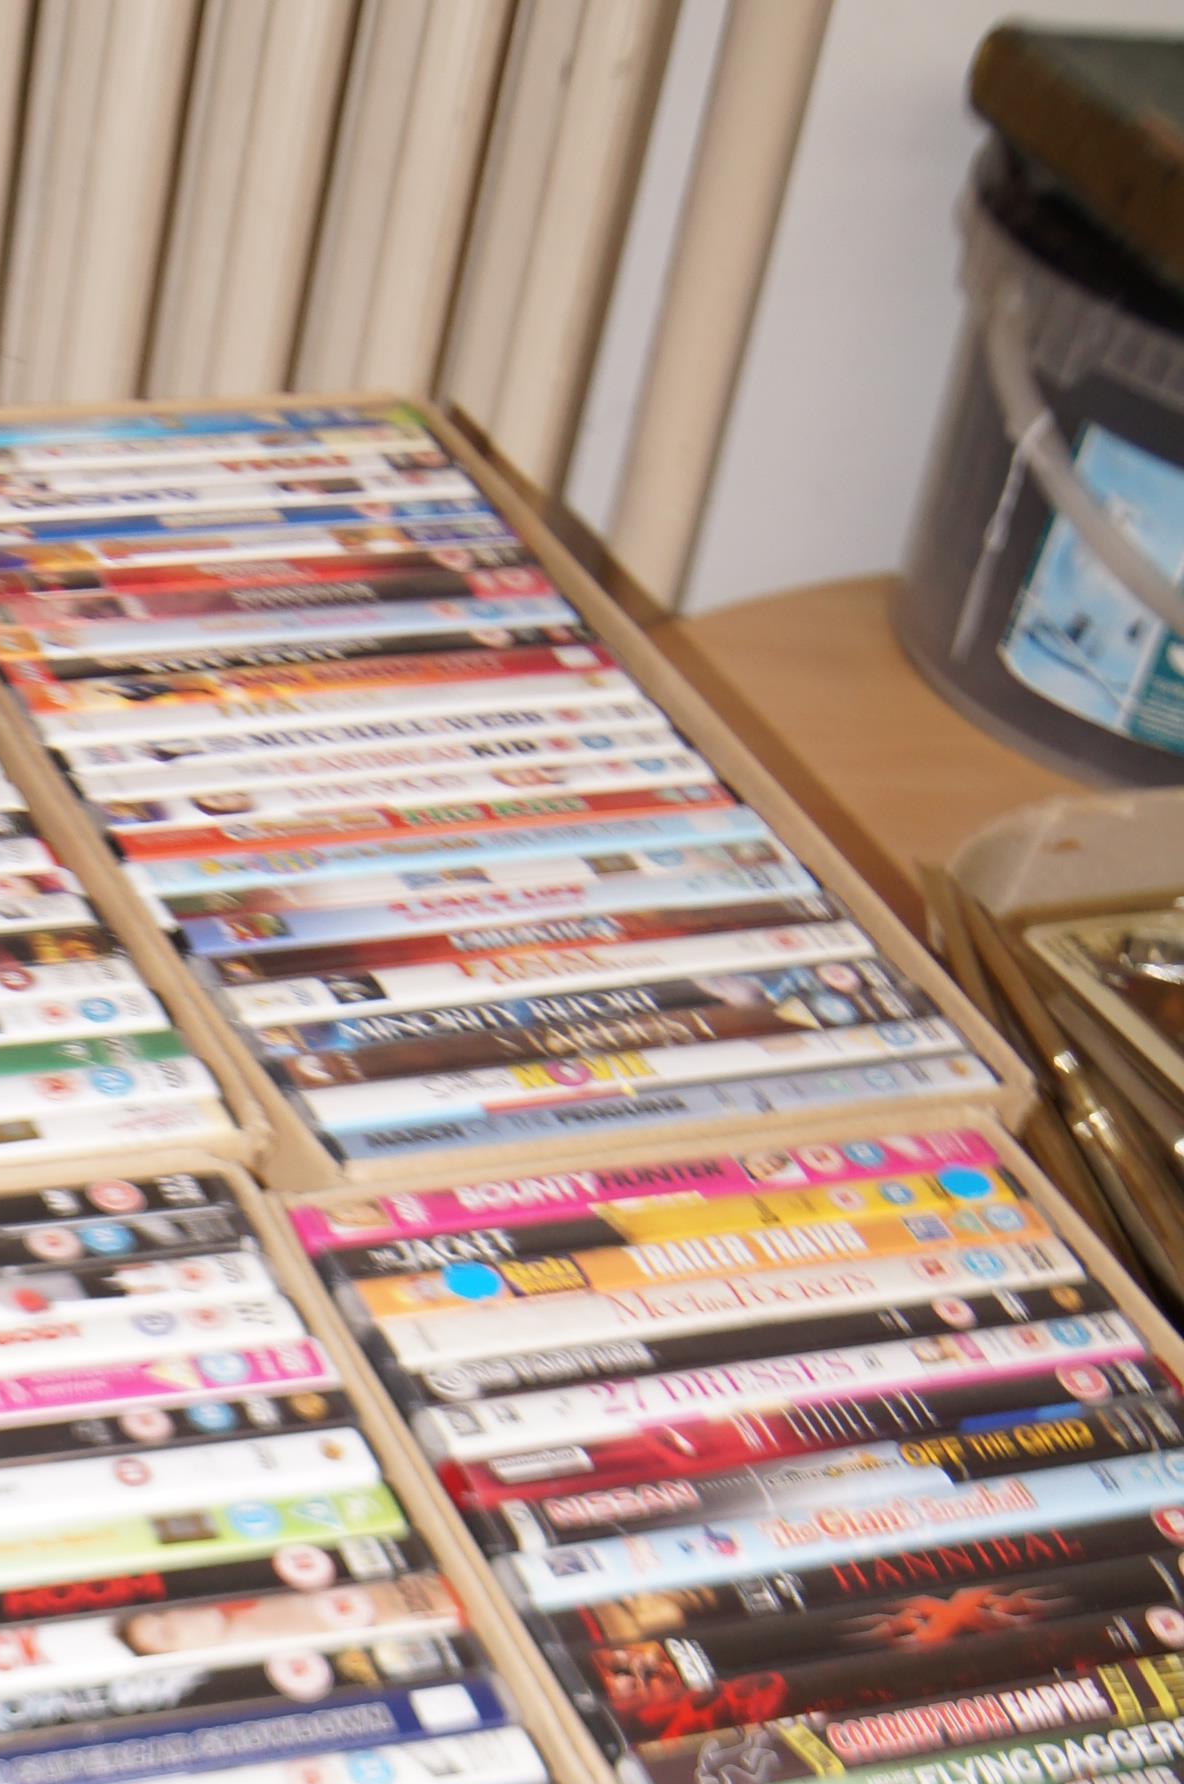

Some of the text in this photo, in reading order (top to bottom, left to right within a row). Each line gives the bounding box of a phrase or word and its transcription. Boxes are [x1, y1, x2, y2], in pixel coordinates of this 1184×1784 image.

[242, 718, 433, 752] MITCHELL
[466, 736, 542, 761] KID
[336, 984, 664, 1044] MINORITY REPORT
[511, 1050, 658, 1092] MOVIE
[366, 1121, 468, 1150] MARCH
[456, 1157, 727, 1213] BOUNTY HUNTER
[394, 1226, 519, 1270] JACKET
[624, 1232, 752, 1278] TRAILER
[588, 1348, 856, 1416] 27 DRESSES
[899, 1438, 968, 1478] OFF
[971, 1434, 1014, 1462] THE
[1011, 1418, 1097, 1455] GRID
[544, 1479, 702, 1526] NISSAN
[764, 1517, 819, 1553] The
[818, 1498, 913, 1545] Giant
[832, 1528, 1086, 1592] HANNIBAL
[2, 1572, 167, 1618] ROOM
[826, 1677, 1114, 1764] CORRUPTION EMPIRE
